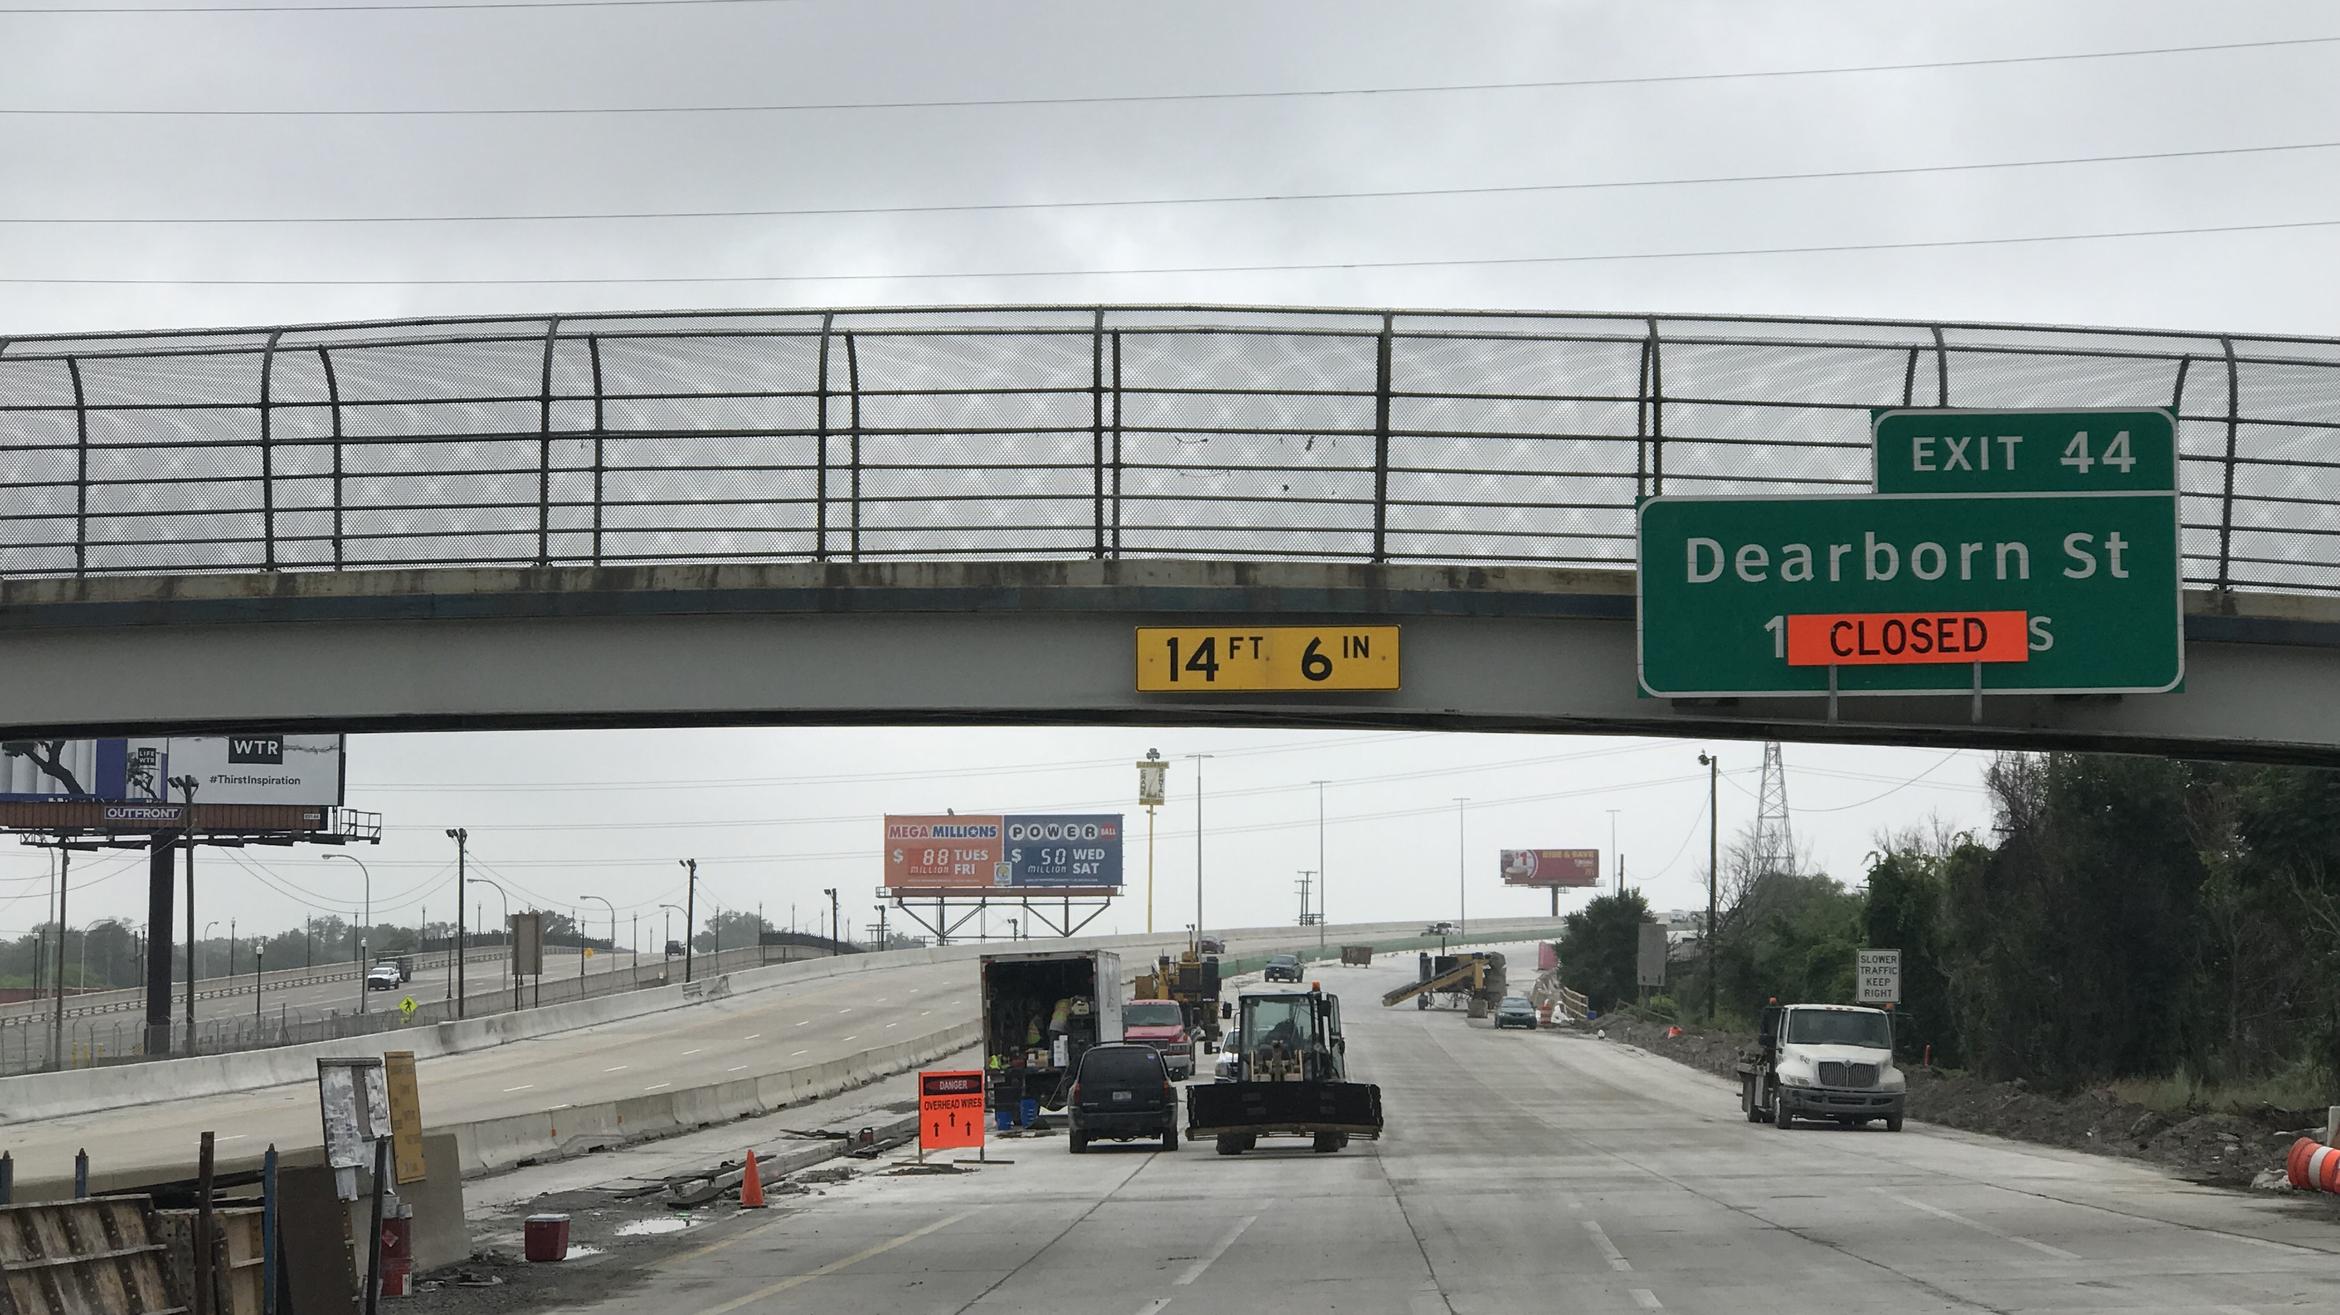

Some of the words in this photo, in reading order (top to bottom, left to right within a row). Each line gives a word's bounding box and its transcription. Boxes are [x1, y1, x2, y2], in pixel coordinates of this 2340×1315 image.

[1912, 435, 2023, 473] EXIT
[2060, 430, 2137, 475] 44
[1685, 531, 2031, 584] Dearborn
[2062, 530, 2130, 580] St
[1829, 616, 1988, 657] CLOSED
[1166, 636, 1219, 682] 14
[1229, 636, 1264, 660] FT
[1301, 636, 1333, 682] 6
[1343, 635, 1370, 659] IN
[233, 740, 279, 755] WTR
[208, 774, 301, 786] #ThirstInspiration
[107, 808, 179, 819] OUTFRONT
[889, 825, 929, 839] MEGA
[932, 825, 997, 838] MILLIONS
[1010, 824, 1098, 840] POWER
[1100, 828, 1117, 836] BALL
[893, 848, 904, 864] $
[922, 848, 949, 866] 88
[954, 849, 989, 861] TUES
[1011, 848, 1022, 864] $
[1042, 848, 1066, 865] 50
[1072, 848, 1106, 860] WED
[910, 866, 949, 874] MILLION
[954, 863, 976, 875] FRI
[1027, 866, 1067, 874] MILLION
[1072, 863, 1100, 874] SAT
[1860, 955, 1897, 964] SLOWER
[1860, 966, 1898, 975] TRAFFIC
[1866, 977, 1891, 986] KEEP
[1864, 989, 1892, 997] RIGHT
[939, 1080, 968, 1090] DANGER
[924, 1099, 960, 1111] OVERHEAD
[960, 1098, 982, 1108] WIRES
